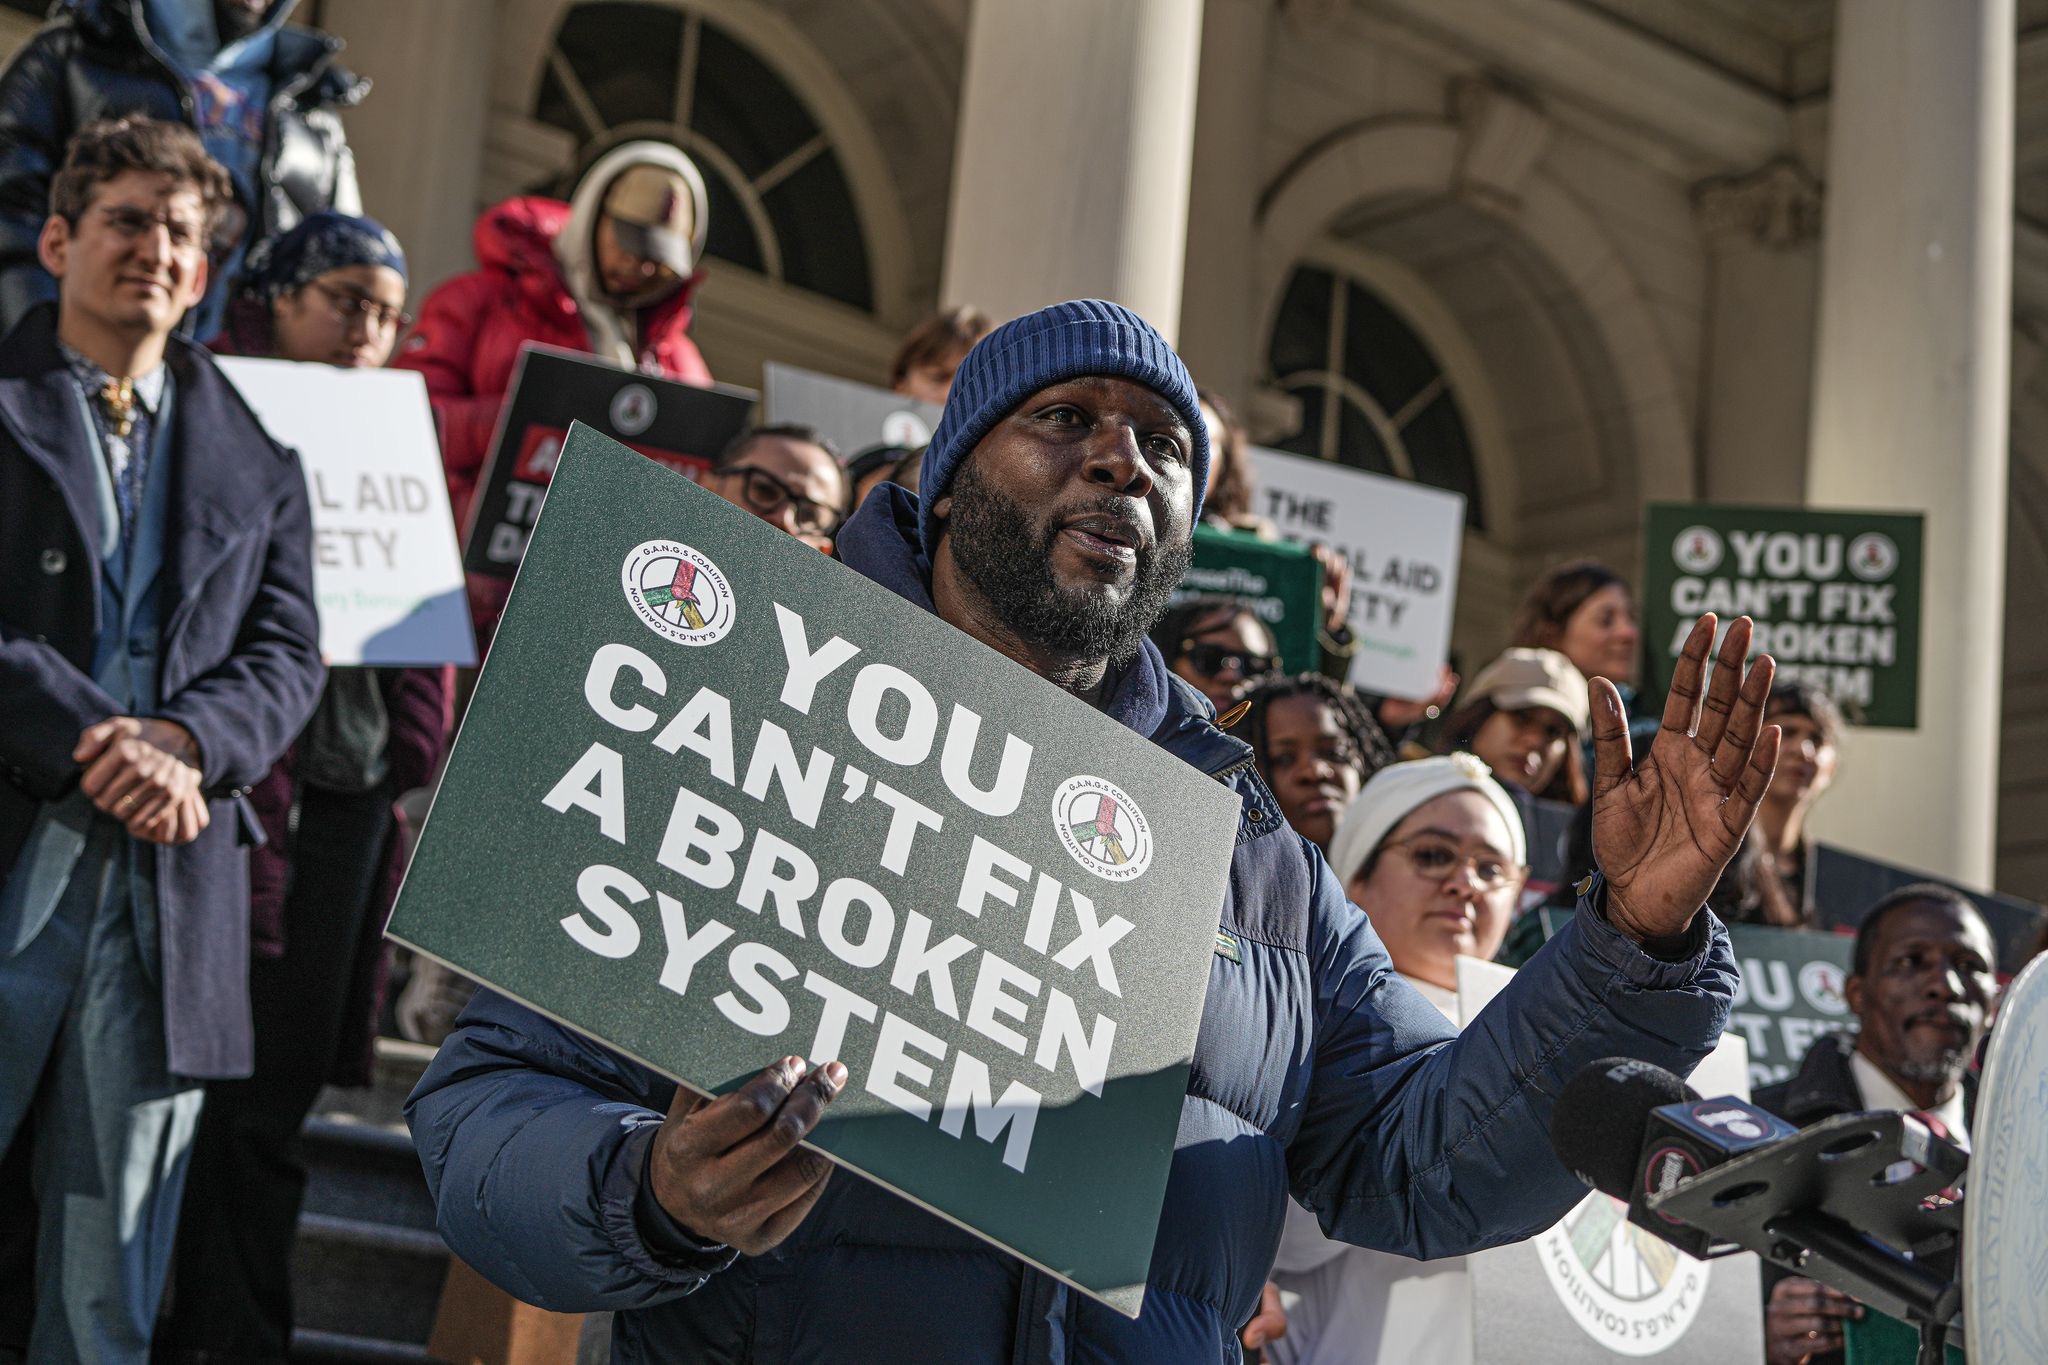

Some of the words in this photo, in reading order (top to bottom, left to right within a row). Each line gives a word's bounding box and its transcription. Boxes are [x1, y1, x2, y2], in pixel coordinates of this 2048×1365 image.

[356, 472, 429, 515] AID
[1266, 486, 1332, 532] THE
[316, 527, 397, 570] ETY
[1729, 531, 1844, 580] YOU
[691, 553, 730, 599] COALITION
[1380, 555, 1442, 594] AID
[629, 586, 669, 633] COALITION
[1818, 582, 1897, 623] FIX
[1712, 622, 1897, 666] ROKEN
[774, 601, 1034, 817] YOU
[1111, 789, 1148, 834] COALITION
[1059, 822, 1096, 869] COALITION
[541, 741, 626, 845] A
[656, 786, 1118, 1099] BROKEN
[956, 834, 1137, 999] FIX
[560, 864, 1042, 1174] SYSTEM
[1548, 1235, 1629, 1337] COALITION
